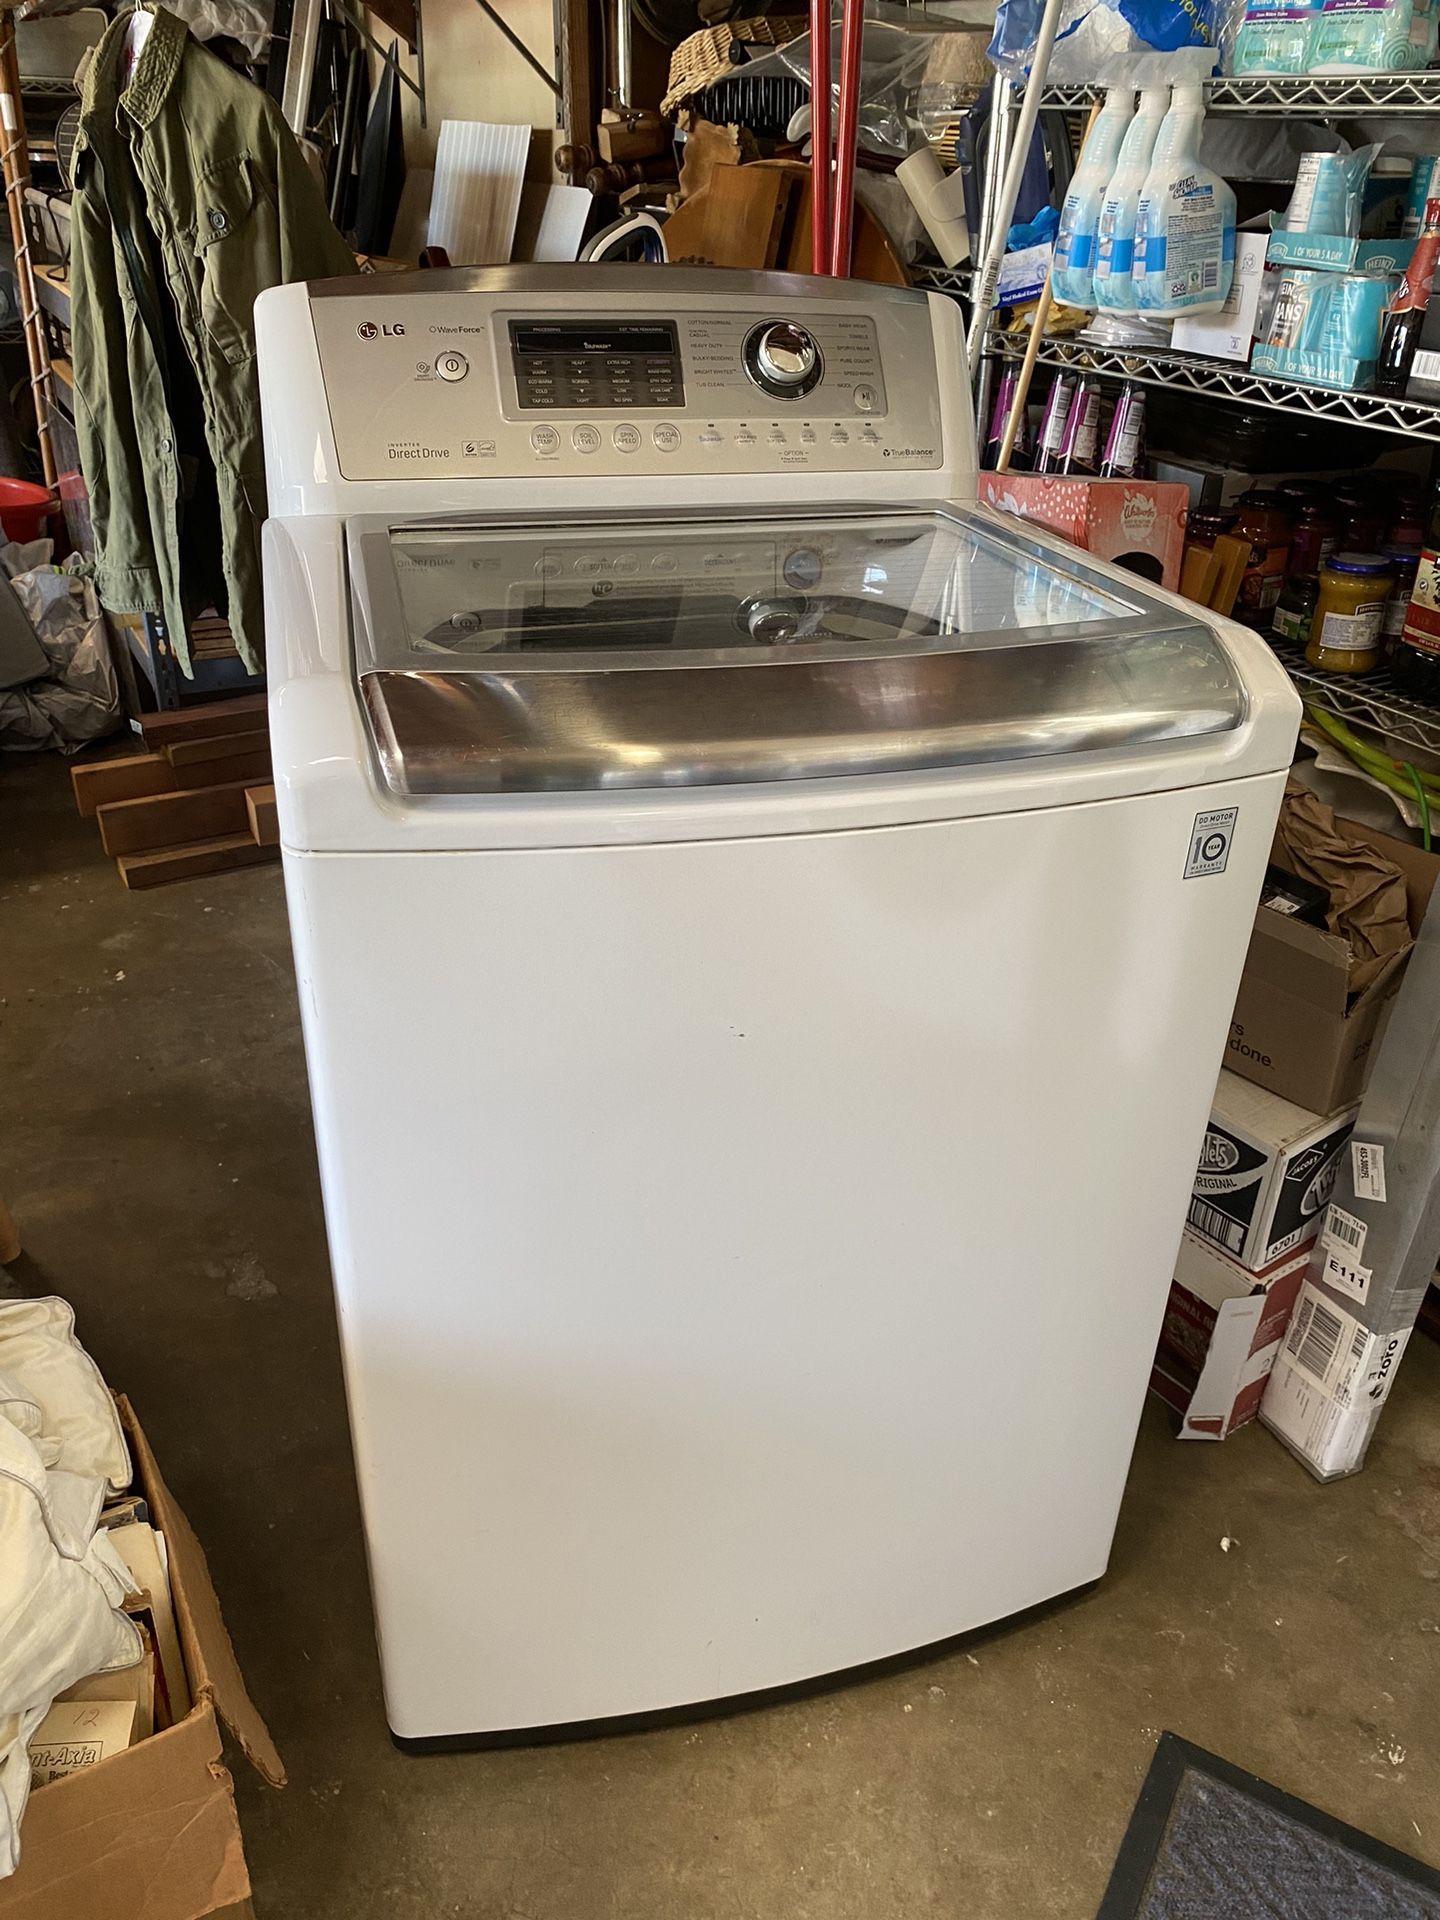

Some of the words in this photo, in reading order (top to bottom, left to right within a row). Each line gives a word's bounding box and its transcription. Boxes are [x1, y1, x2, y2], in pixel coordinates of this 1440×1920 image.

[1297, 248, 1305, 257] OF
[1305, 248, 1321, 259] YOUR
[1330, 252, 1344, 261] DAY
[1368, 259, 1392, 271] HEINZ
[381, 324, 406, 336] LG
[388, 449, 421, 459] Direct
[422, 448, 450, 459] Drive
[1199, 817, 1209, 825] DD
[1209, 813, 1233, 823] MOTOR
[1192, 833, 1227, 864] 10
[1191, 862, 1222, 871] WARRANTY
[1195, 1176, 1238, 1190] RIGINAL
[1271, 1234, 1296, 1255] 6701
[1329, 1259, 1365, 1289] E111
[1377, 1340, 1399, 1380] zoro
[72, 1708, 100, 1727] 12
